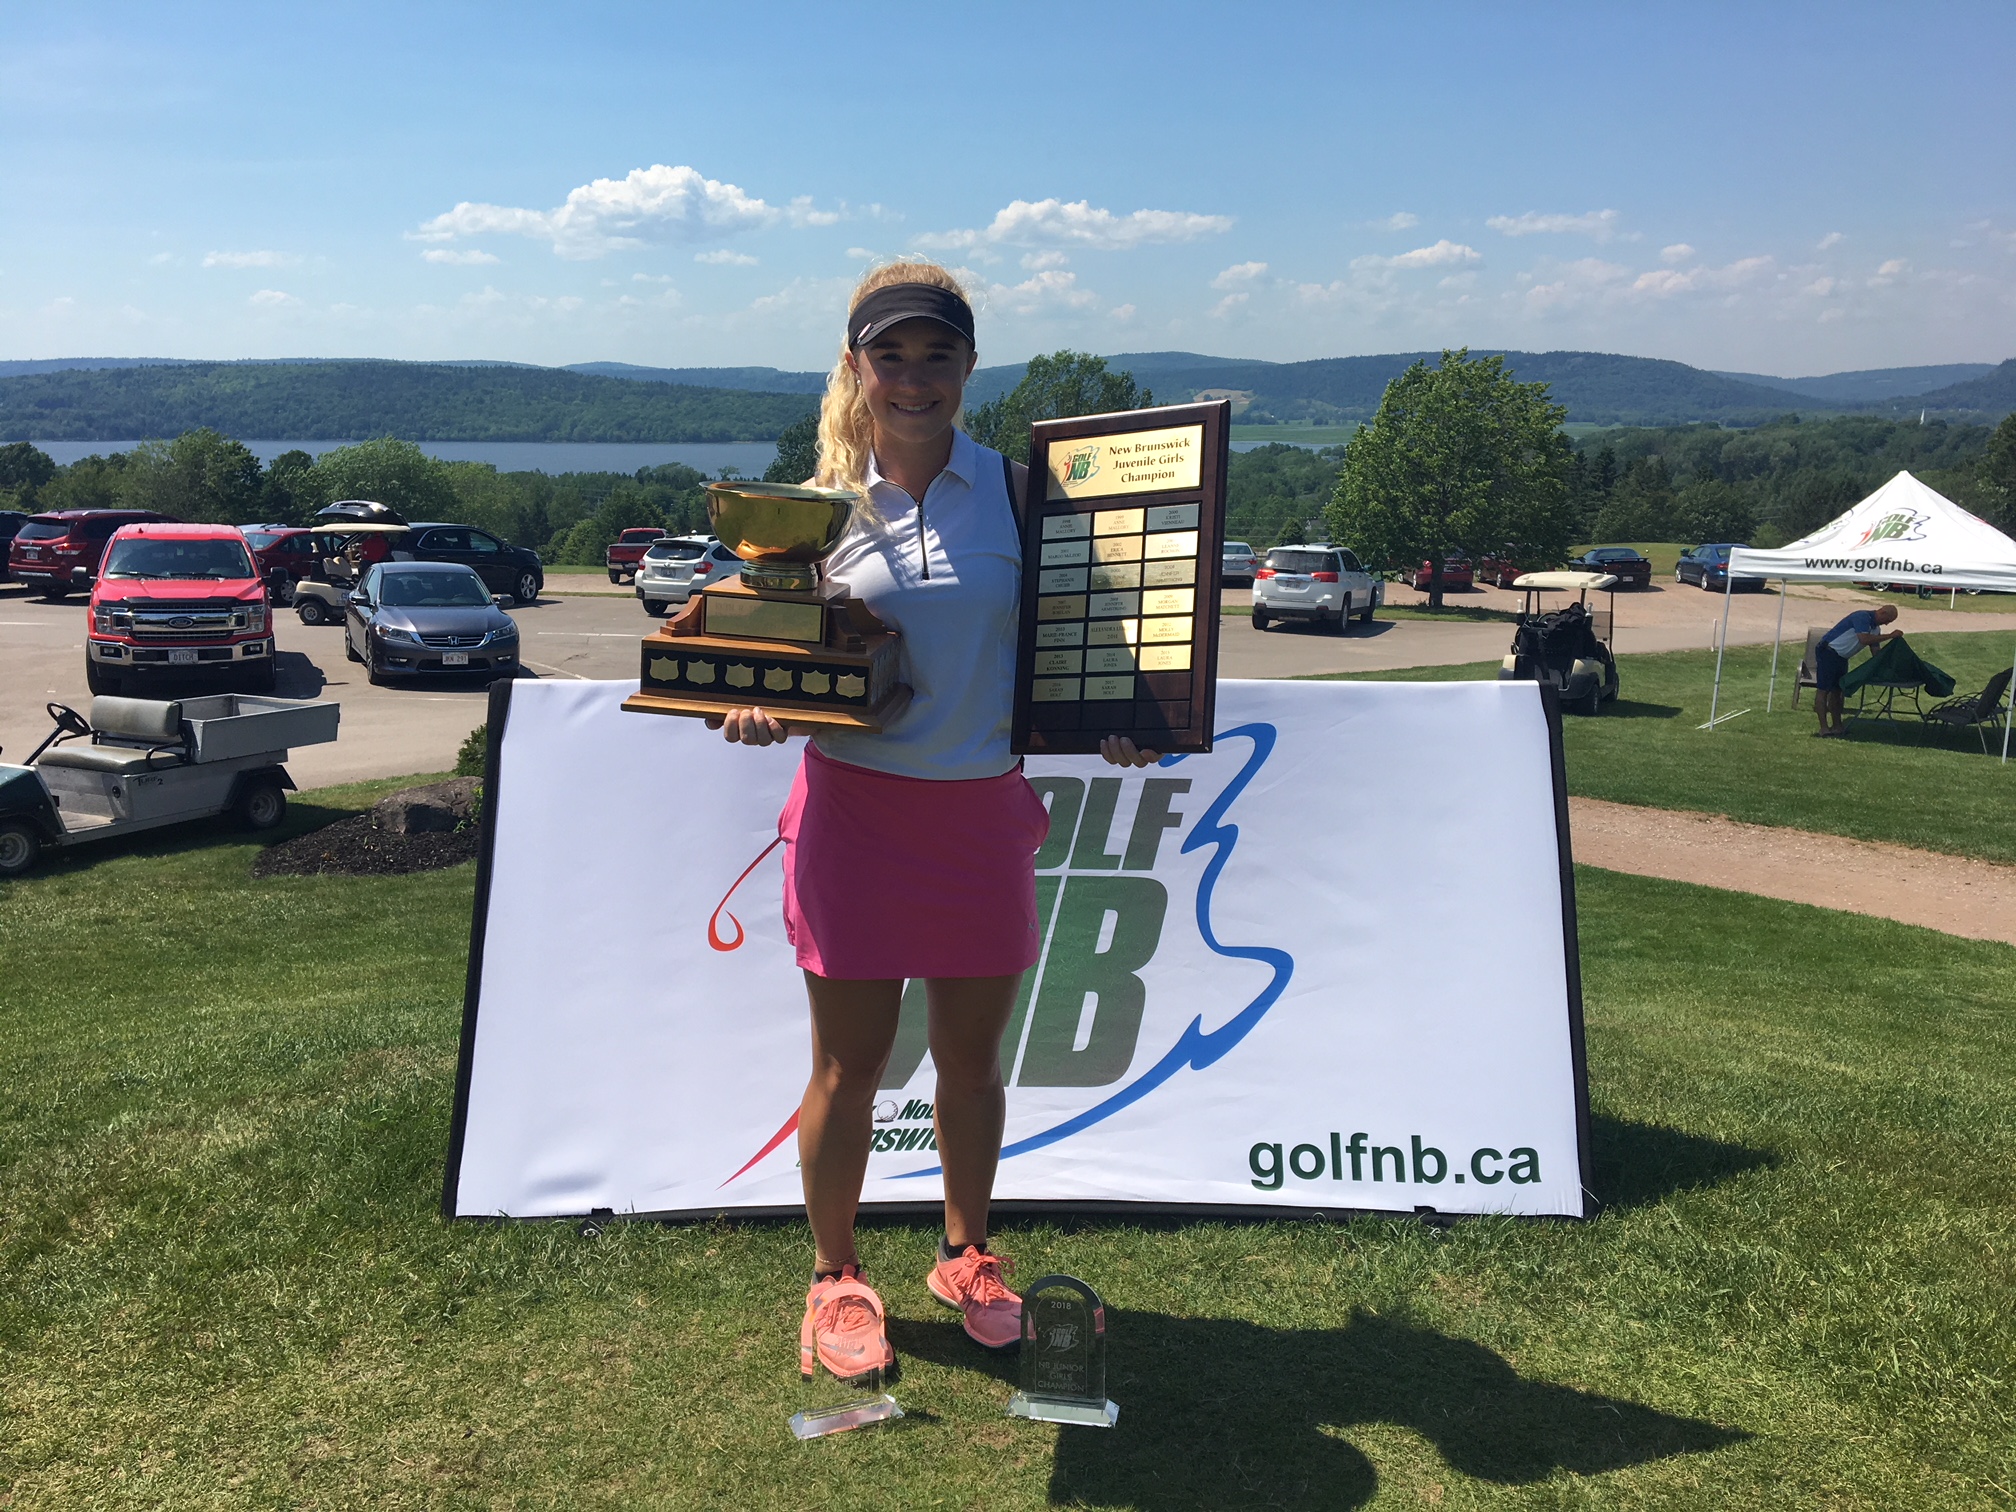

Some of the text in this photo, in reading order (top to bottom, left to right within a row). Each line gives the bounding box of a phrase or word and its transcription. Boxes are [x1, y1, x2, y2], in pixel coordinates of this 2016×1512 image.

[1109, 437, 1190, 456] New Brunswick
[1072, 452, 1093, 462] GOLF
[1113, 453, 1185, 470] Juvenile Girls
[1065, 461, 1091, 482] NB
[1121, 469, 1175, 483] Champion
[1864, 522, 1911, 544] NB
[1804, 557, 1943, 575] www.golfnb.ca
[1027, 776, 1193, 871] OLF
[1248, 1132, 1542, 1192] golfnb.ca
[1051, 1301, 1072, 1310] 2018
[1038, 1361, 1085, 1373] NB JUNIOR
[1050, 1371, 1073, 1381] GIRLS
[1037, 1380, 1085, 1392] CHAMPION
